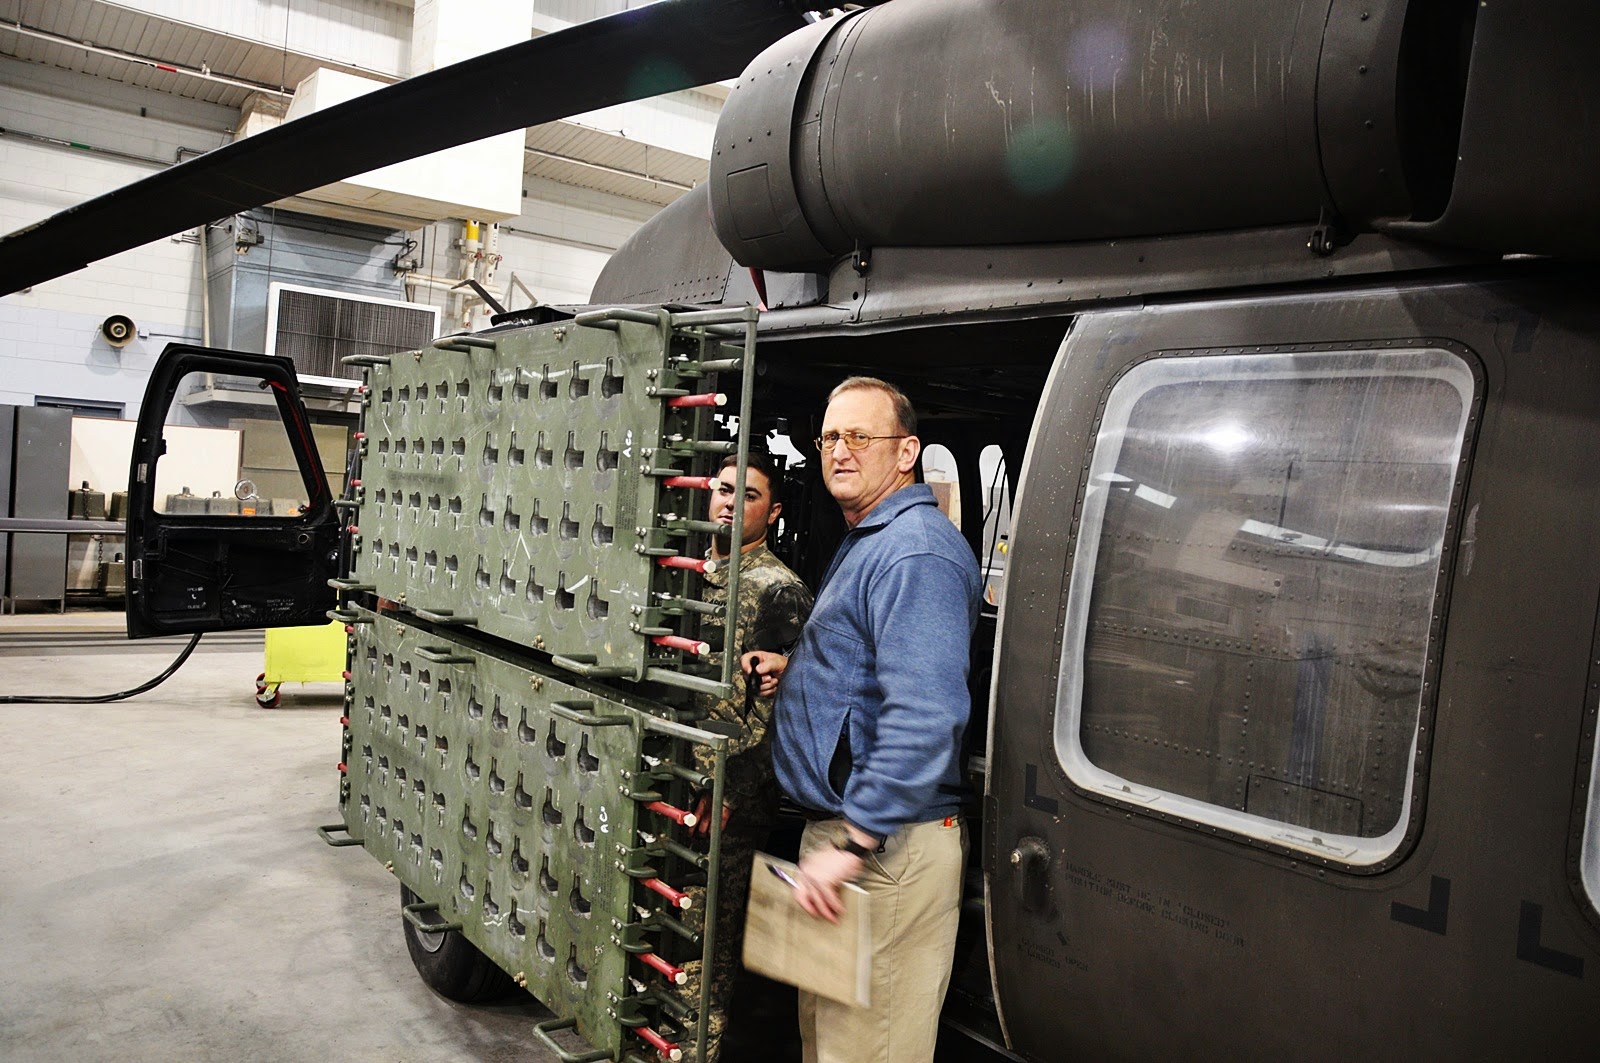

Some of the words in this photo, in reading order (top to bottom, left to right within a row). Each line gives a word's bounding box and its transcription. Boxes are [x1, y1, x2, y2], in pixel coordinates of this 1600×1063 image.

[1065, 872, 1113, 897] POSITION
[1117, 892, 1156, 914] BEFORE
[1161, 909, 1210, 935] CLOSING
[1066, 862, 1101, 883] HANDLE
[1106, 877, 1132, 892] MUST
[1159, 897, 1171, 908] IN
